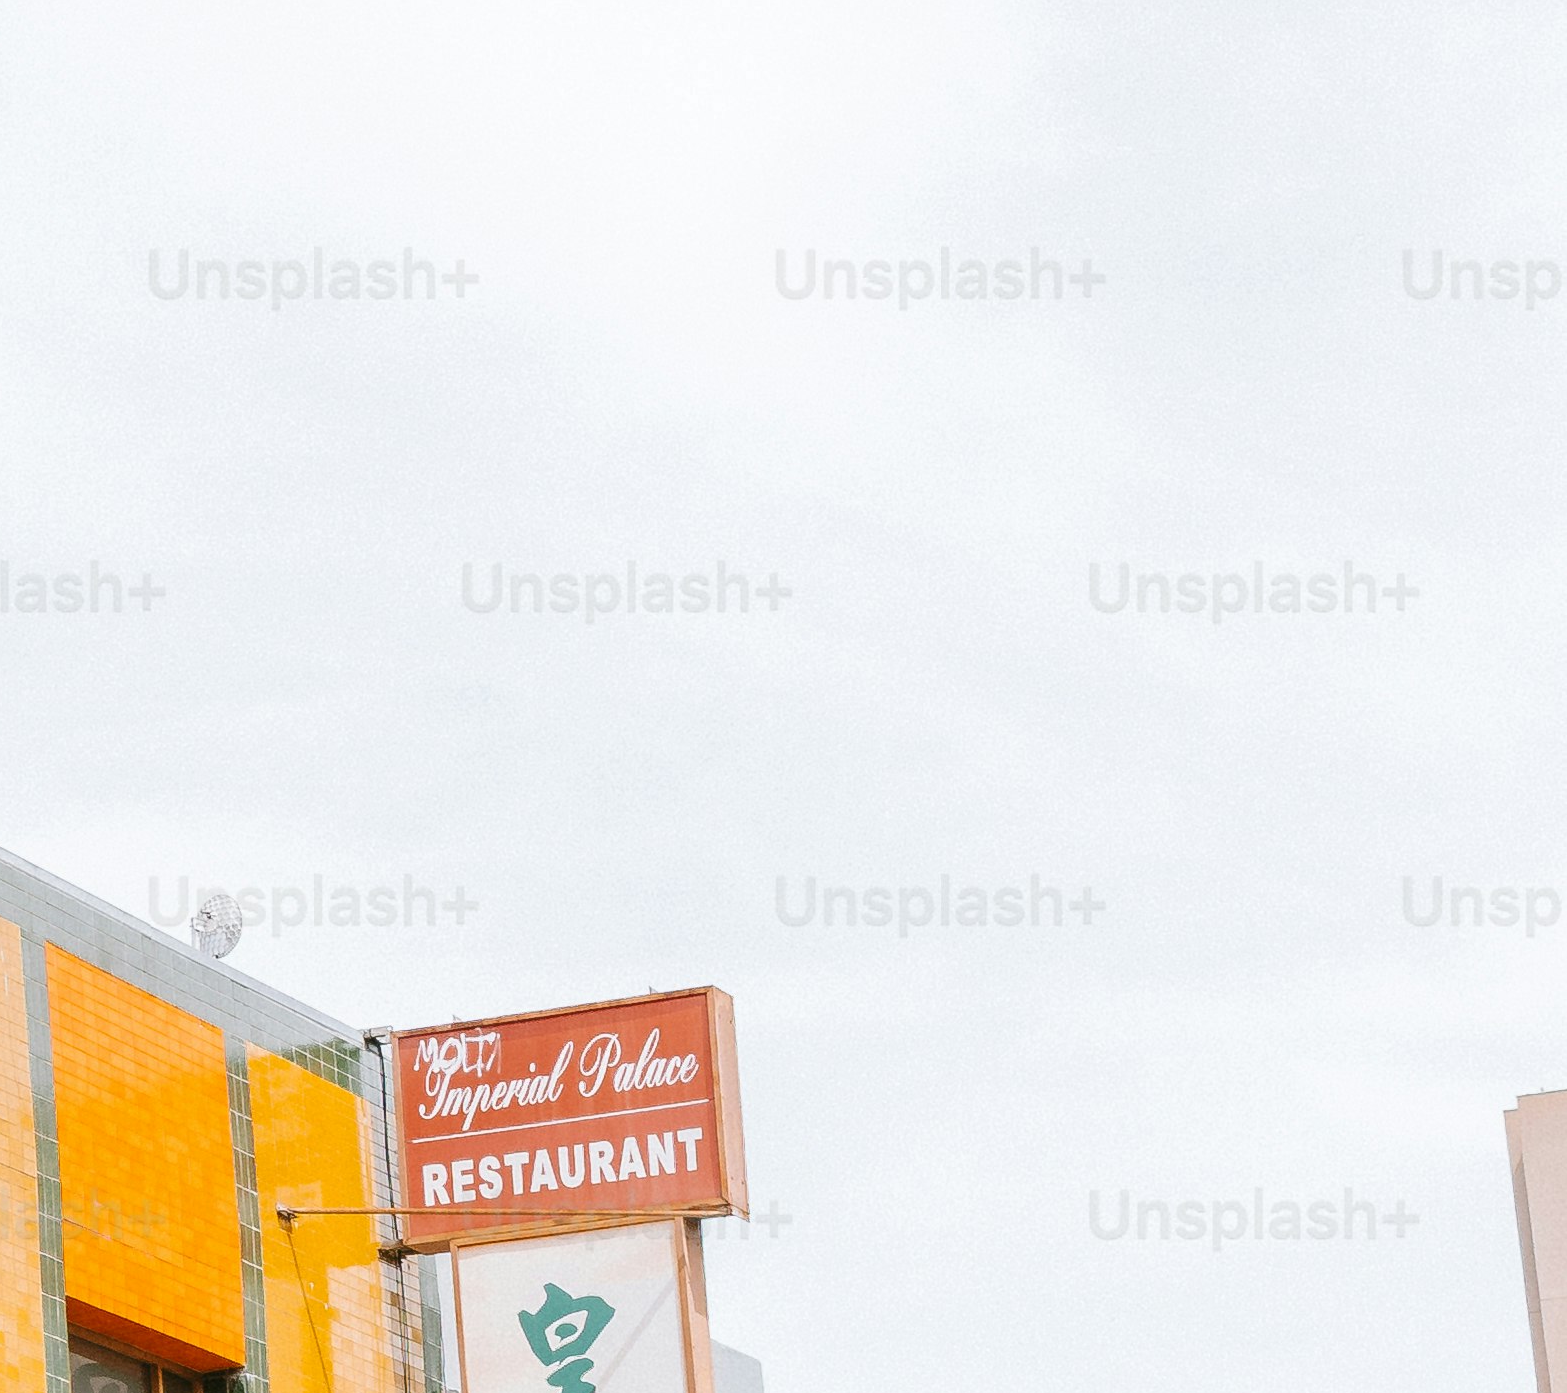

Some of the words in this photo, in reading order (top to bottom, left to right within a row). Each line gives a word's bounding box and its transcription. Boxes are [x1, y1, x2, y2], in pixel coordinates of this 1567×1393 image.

[418, 1040, 575, 1132] Imperial
[577, 1027, 700, 1099] Palace
[422, 1127, 704, 1208] RESTAURANT
